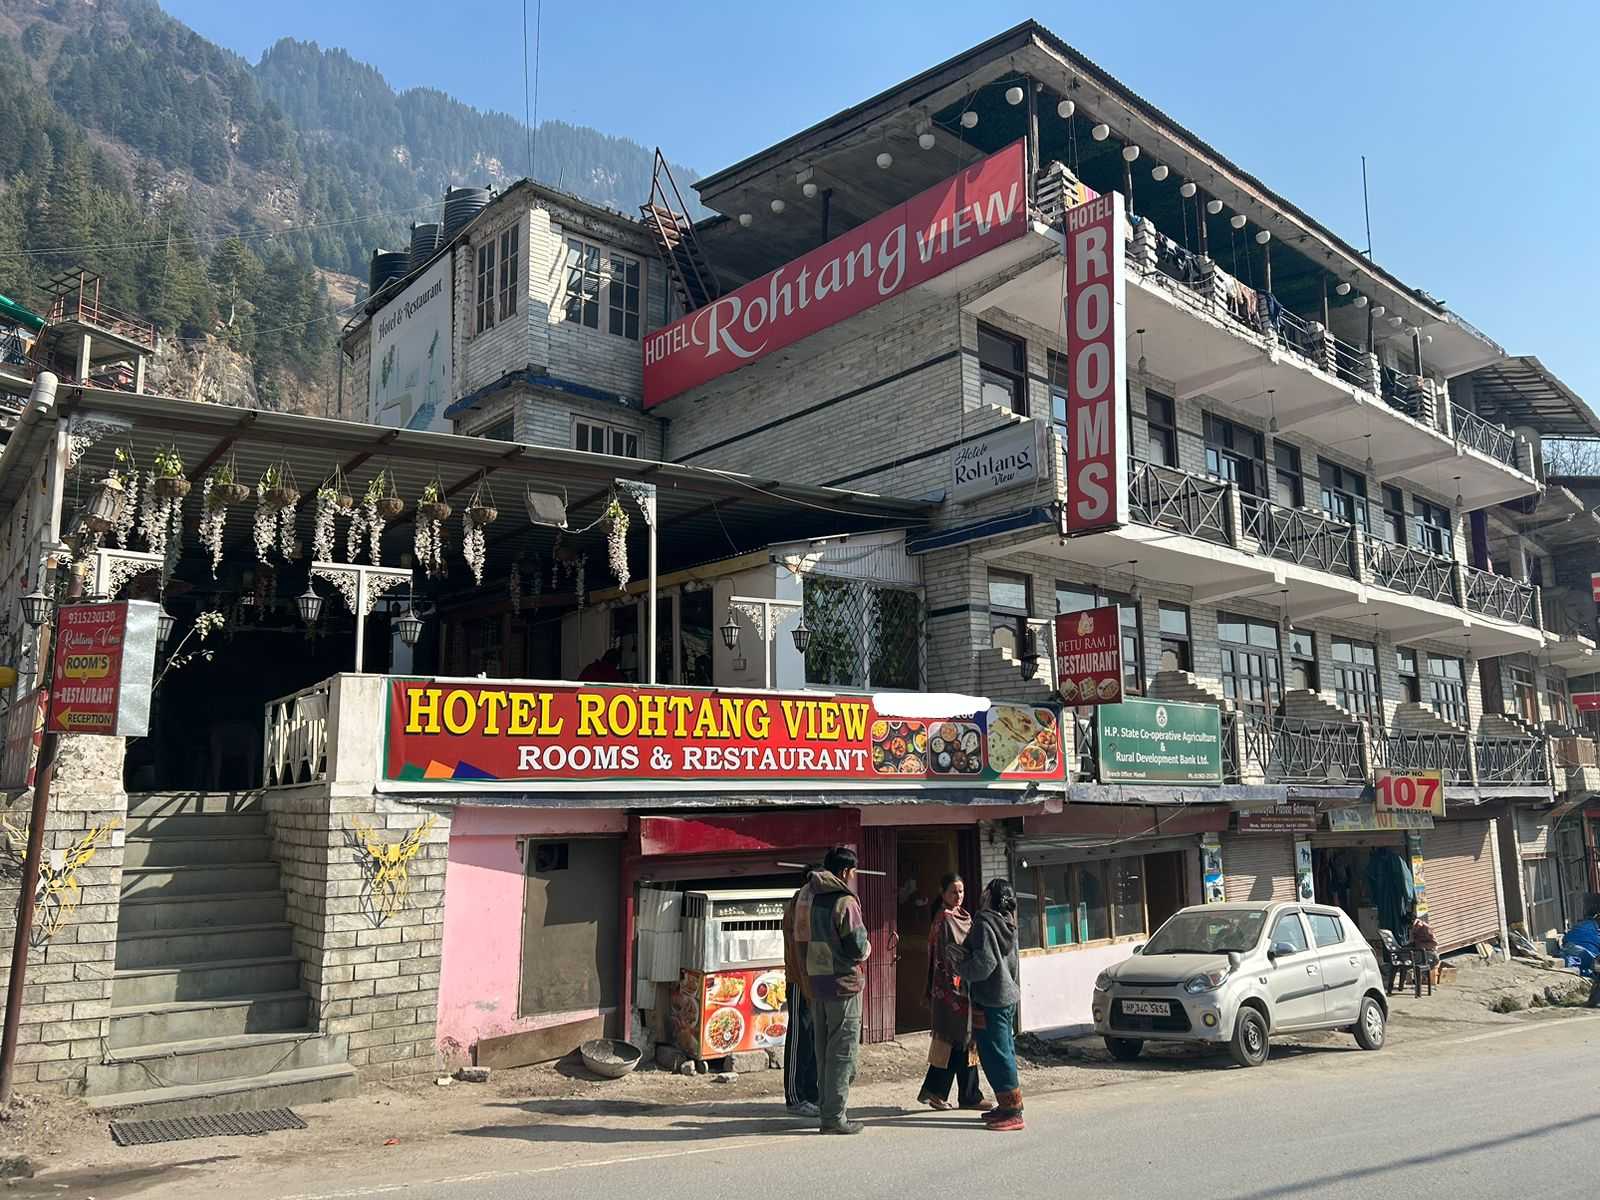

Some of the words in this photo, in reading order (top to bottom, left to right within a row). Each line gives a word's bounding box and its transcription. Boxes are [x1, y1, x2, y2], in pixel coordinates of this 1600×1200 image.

[1069, 197, 1113, 234] HOTEL
[645, 325, 690, 367] HOTEL
[691, 223, 908, 359] Rohtang
[915, 182, 1018, 264] VIEW
[378, 312, 397, 344] Hotel
[404, 278, 443, 319] Restaurant
[1075, 226, 1110, 521] ROOMS
[955, 443, 988, 466] Hotel
[955, 446, 1033, 485] Rohtang
[992, 473, 1015, 486] View
[1058, 640, 1082, 653] PETU
[1085, 636, 1106, 649] RAM
[1109, 634, 1116, 649] JI
[66, 656, 108, 670] ROOM'S
[1058, 650, 1118, 675] RESTAURANT
[61, 687, 114, 704] RESTAURANT
[68, 713, 112, 724] RECEPTION
[404, 688, 564, 736] HOTEL
[577, 693, 771, 740] ROHTANG
[780, 700, 869, 741] VIEW
[1104, 726, 1119, 737] H.P.
[1121, 728, 1139, 738] State
[1140, 729, 1182, 741] Co-operative
[1183, 732, 1217, 743] Agriculture
[517, 745, 640, 771] ROOMS
[650, 747, 672, 770] &
[682, 747, 868, 771] RESTAURANT
[1116, 752, 1135, 762] Rural
[1136, 753, 1179, 765] Development
[1180, 755, 1196, 764] Bank
[1197, 755, 1209, 765] Ltd.
[1160, 742, 1166, 752] &
[1376, 775, 1440, 808] 107
